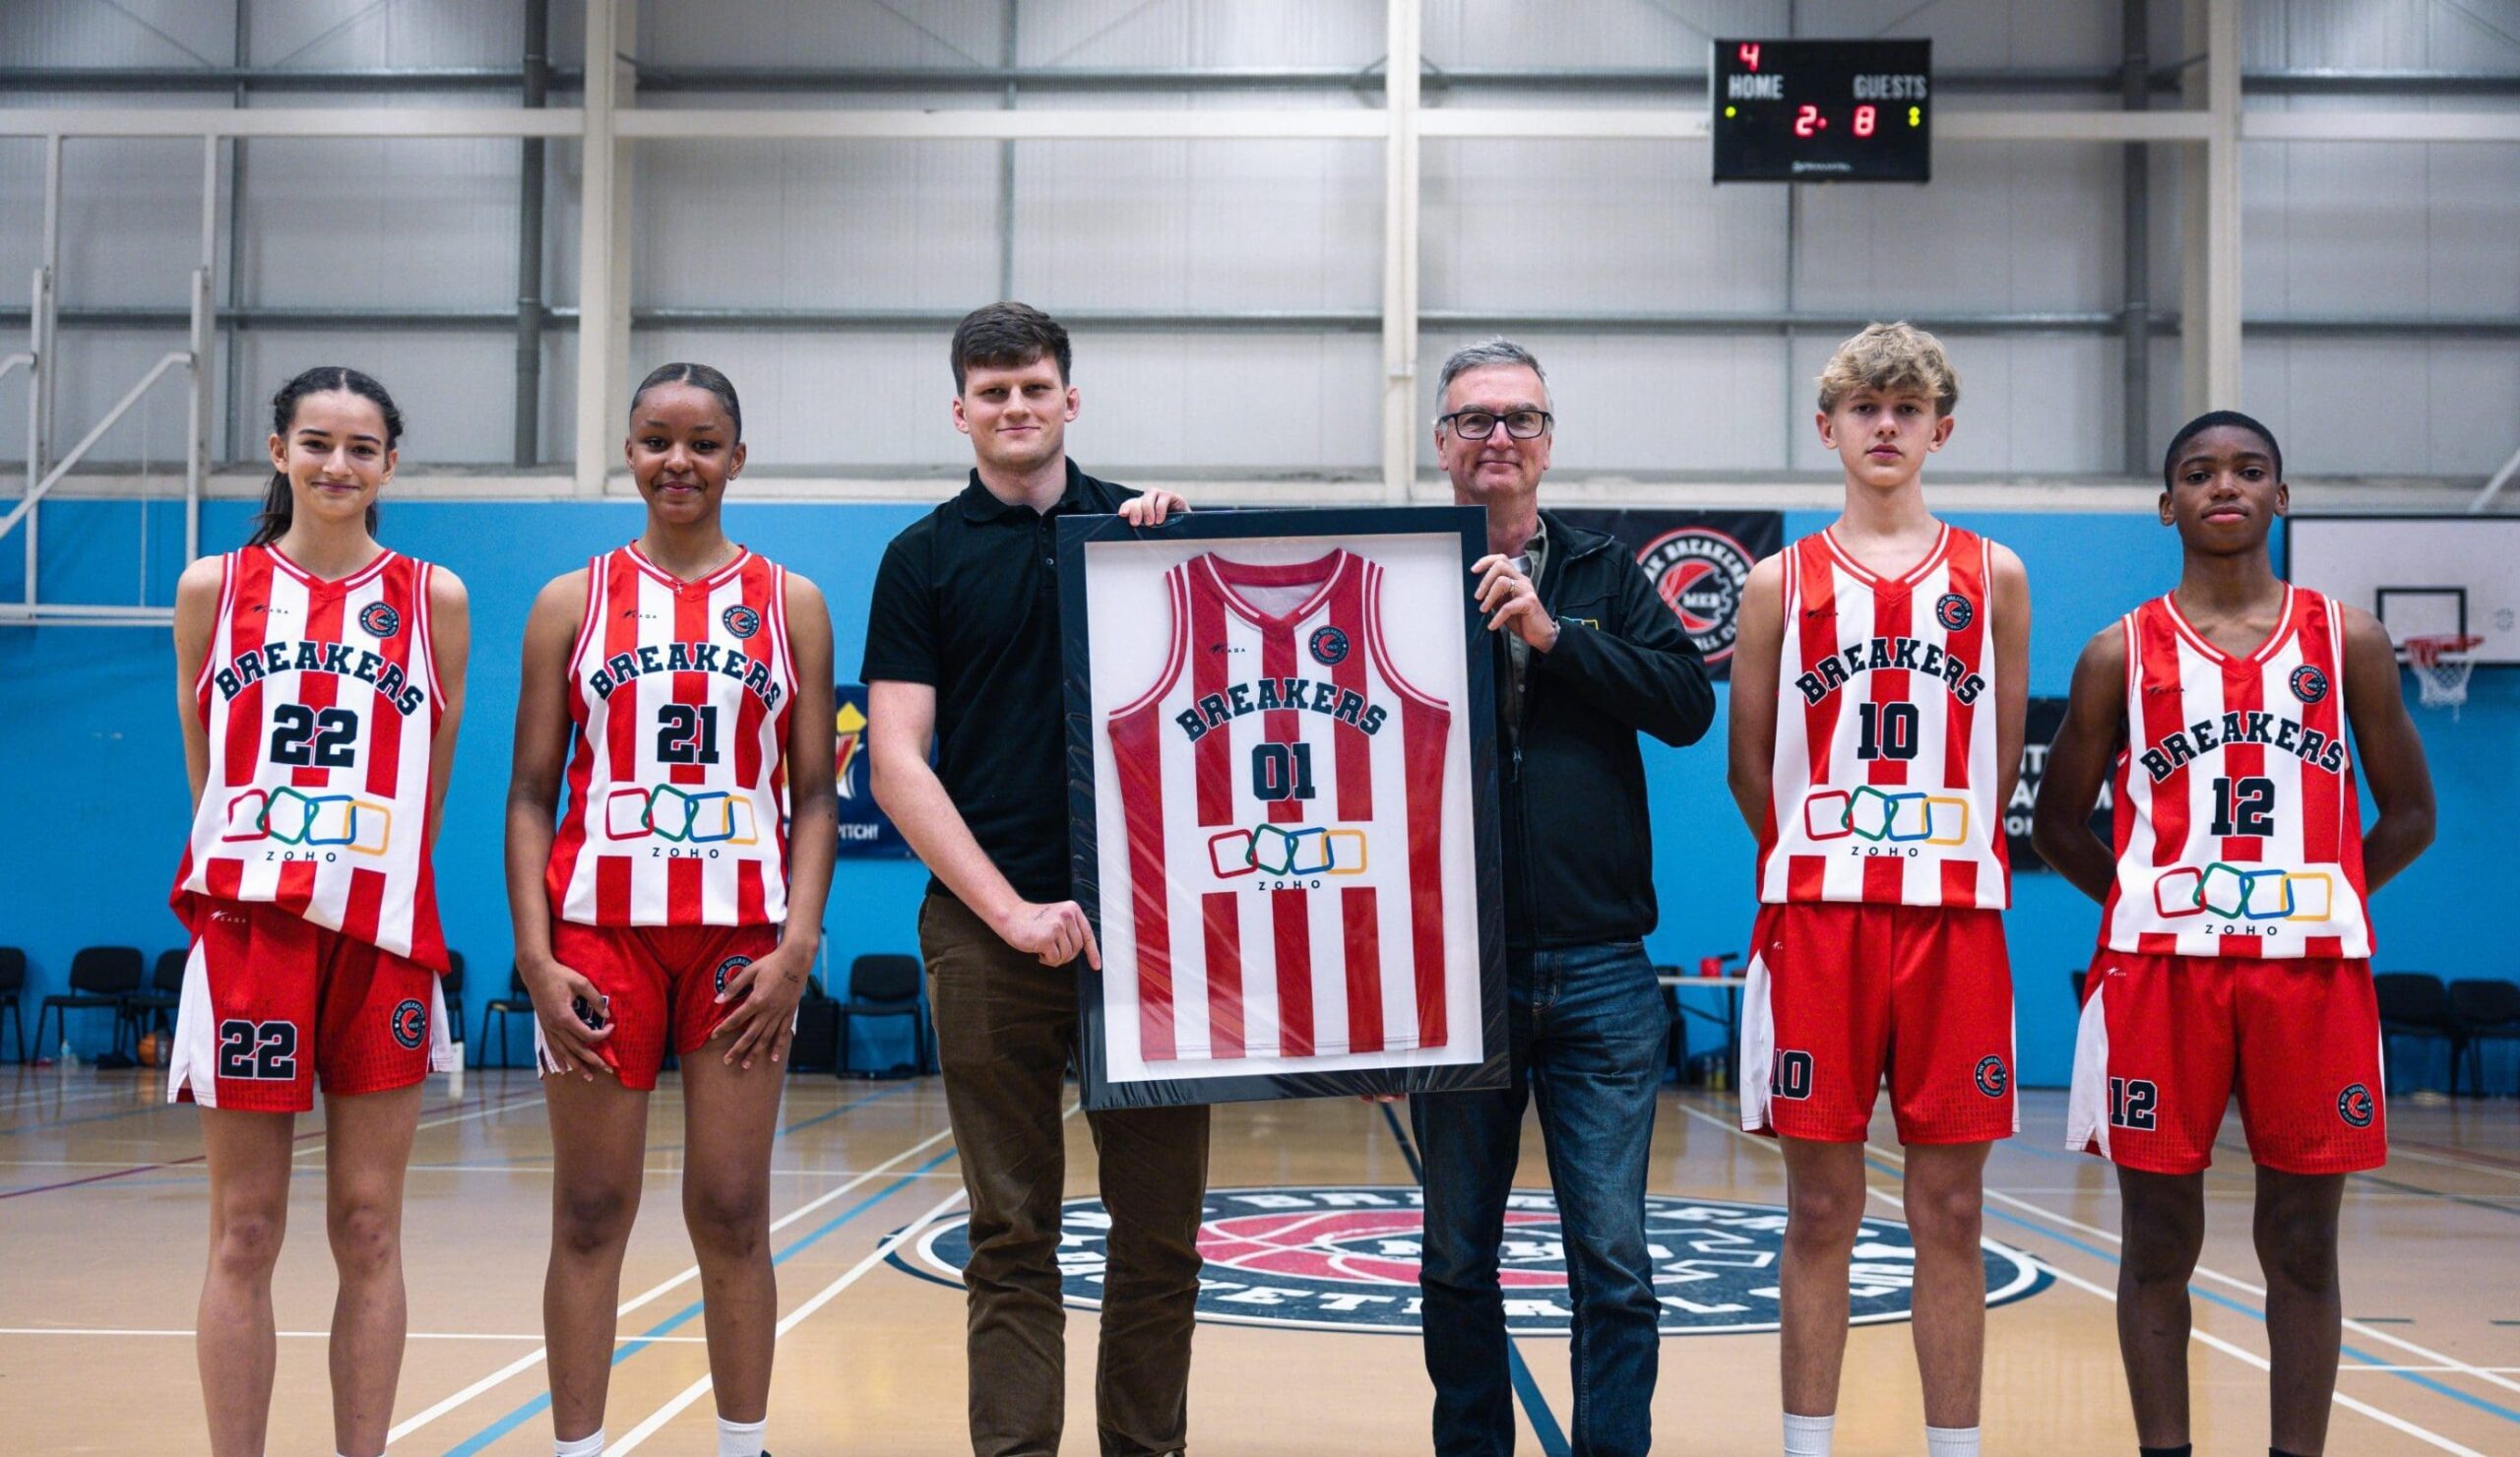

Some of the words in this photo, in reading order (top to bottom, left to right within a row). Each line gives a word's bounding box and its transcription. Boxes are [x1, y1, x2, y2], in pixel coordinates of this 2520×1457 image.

[1738, 42, 1761, 72] 4
[1728, 74, 1785, 99] HOME
[1853, 74, 1927, 100] GUESTS
[1853, 104, 1877, 137] 8
[215, 641, 424, 716] BREAKERS
[589, 642, 783, 712] BREAKERS
[1795, 637, 1986, 706] BREAKERS
[270, 703, 359, 768] 22
[657, 704, 720, 764] 21
[1176, 677, 1388, 742] BREAKERS
[1857, 702, 1920, 760] 10
[1251, 742, 1316, 801] 01
[2140, 711, 2345, 784] BREAKERS
[2210, 777, 2276, 837] 12
[266, 851, 337, 862] ZOHO
[652, 847, 720, 859] ZOHO
[1851, 846, 1919, 857] ZOHO
[1258, 879, 1321, 891] ZOHO
[2204, 923, 2278, 936] ZOHO
[219, 1019, 297, 1080] 22
[1770, 1047, 1814, 1101] 10
[2109, 1077, 2158, 1131] 12
